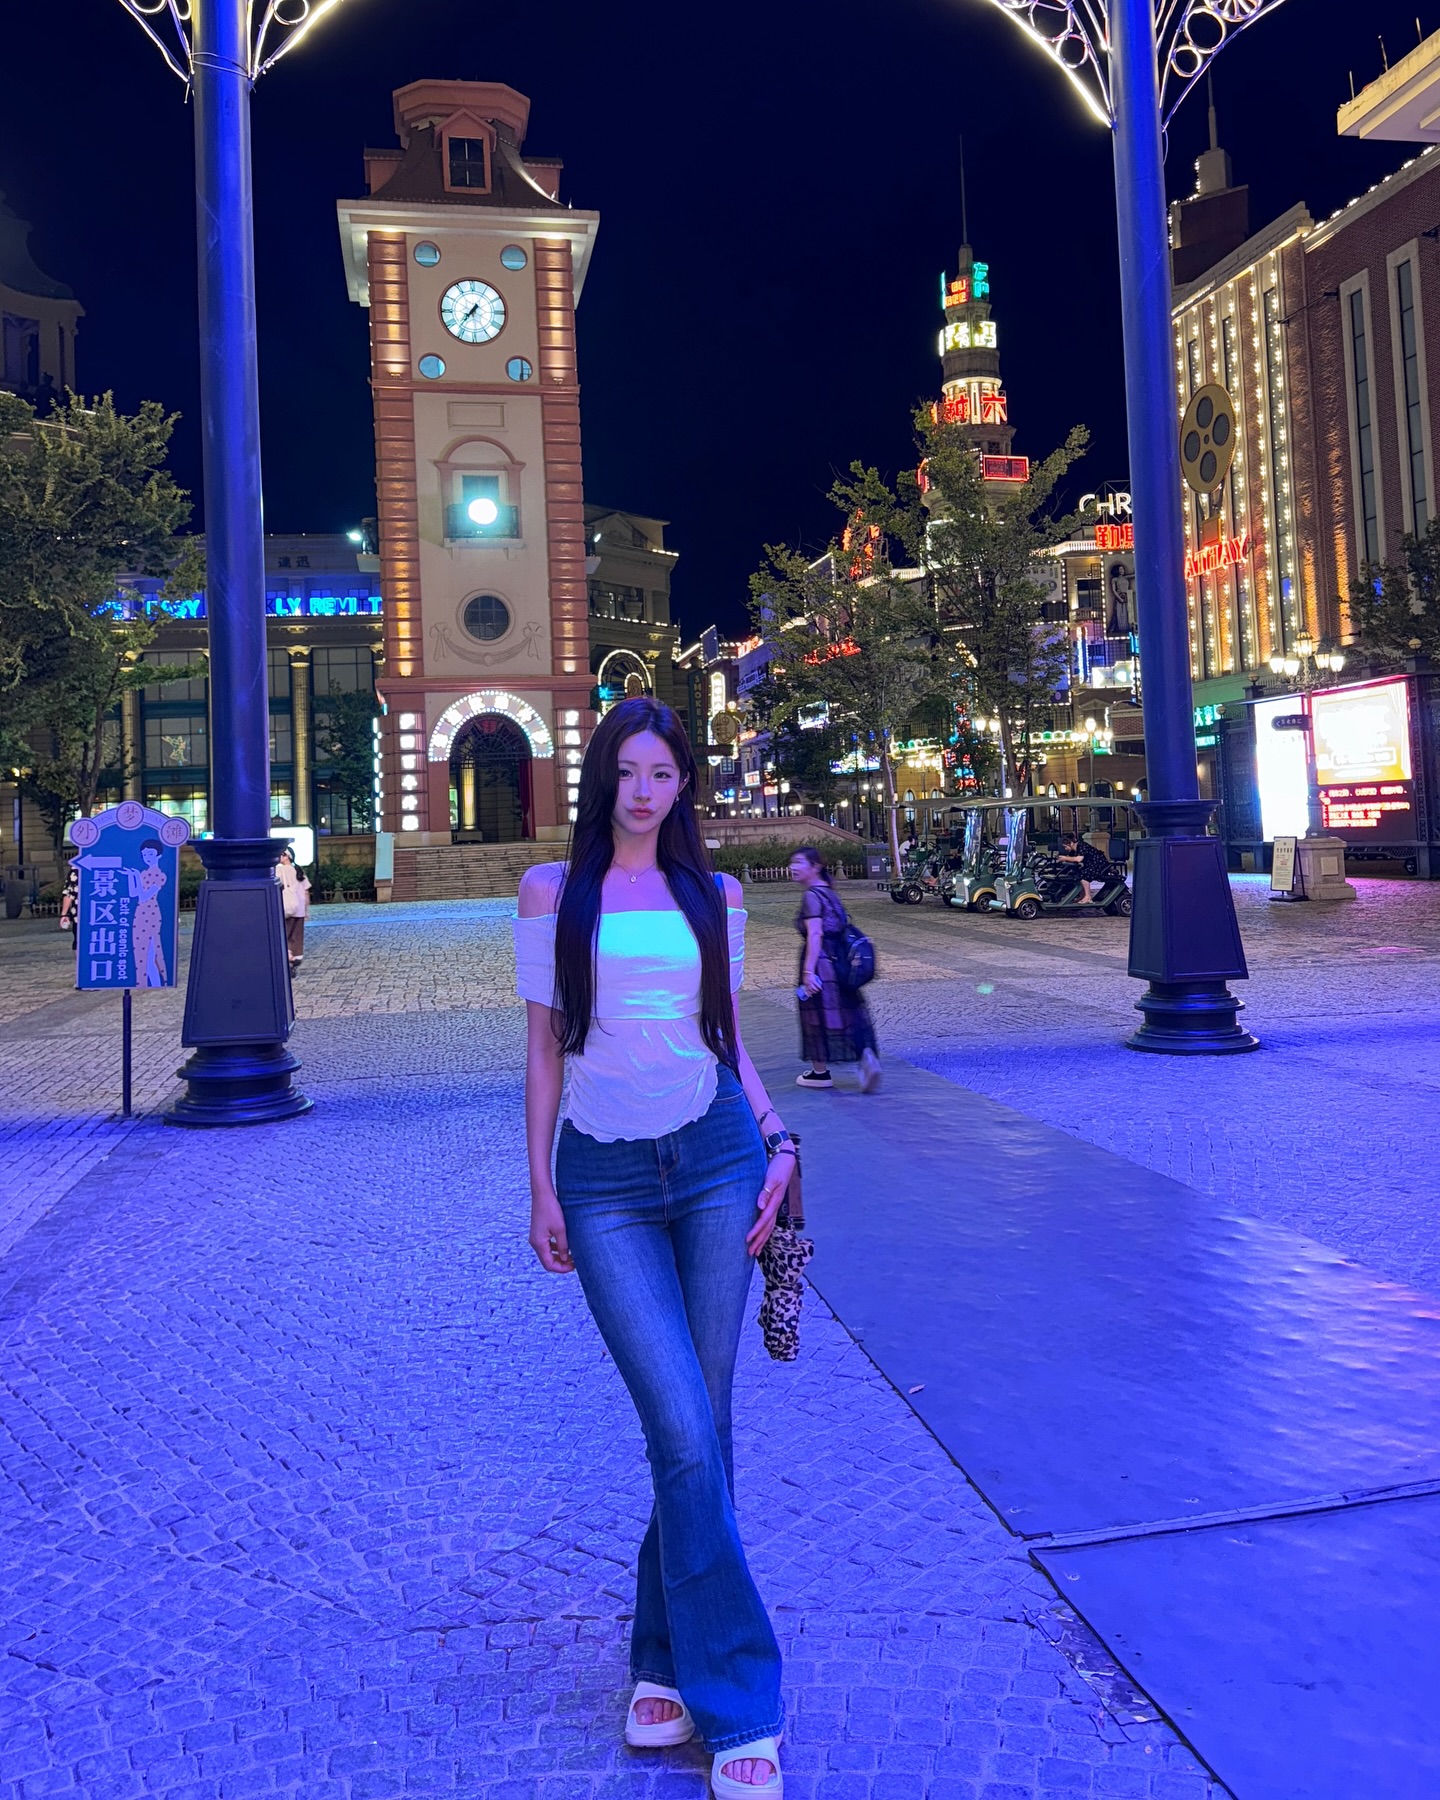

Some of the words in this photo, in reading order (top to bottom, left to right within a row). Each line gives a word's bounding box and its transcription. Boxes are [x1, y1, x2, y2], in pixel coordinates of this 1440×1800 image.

[693, 675, 702, 716] SMOKE
[696, 719, 704, 744] BAR
[119, 897, 130, 915] Exit
[89, 870, 119, 981] 景区出口
[119, 916, 130, 927] of
[118, 928, 129, 958] scenic
[116, 959, 129, 980] spot
